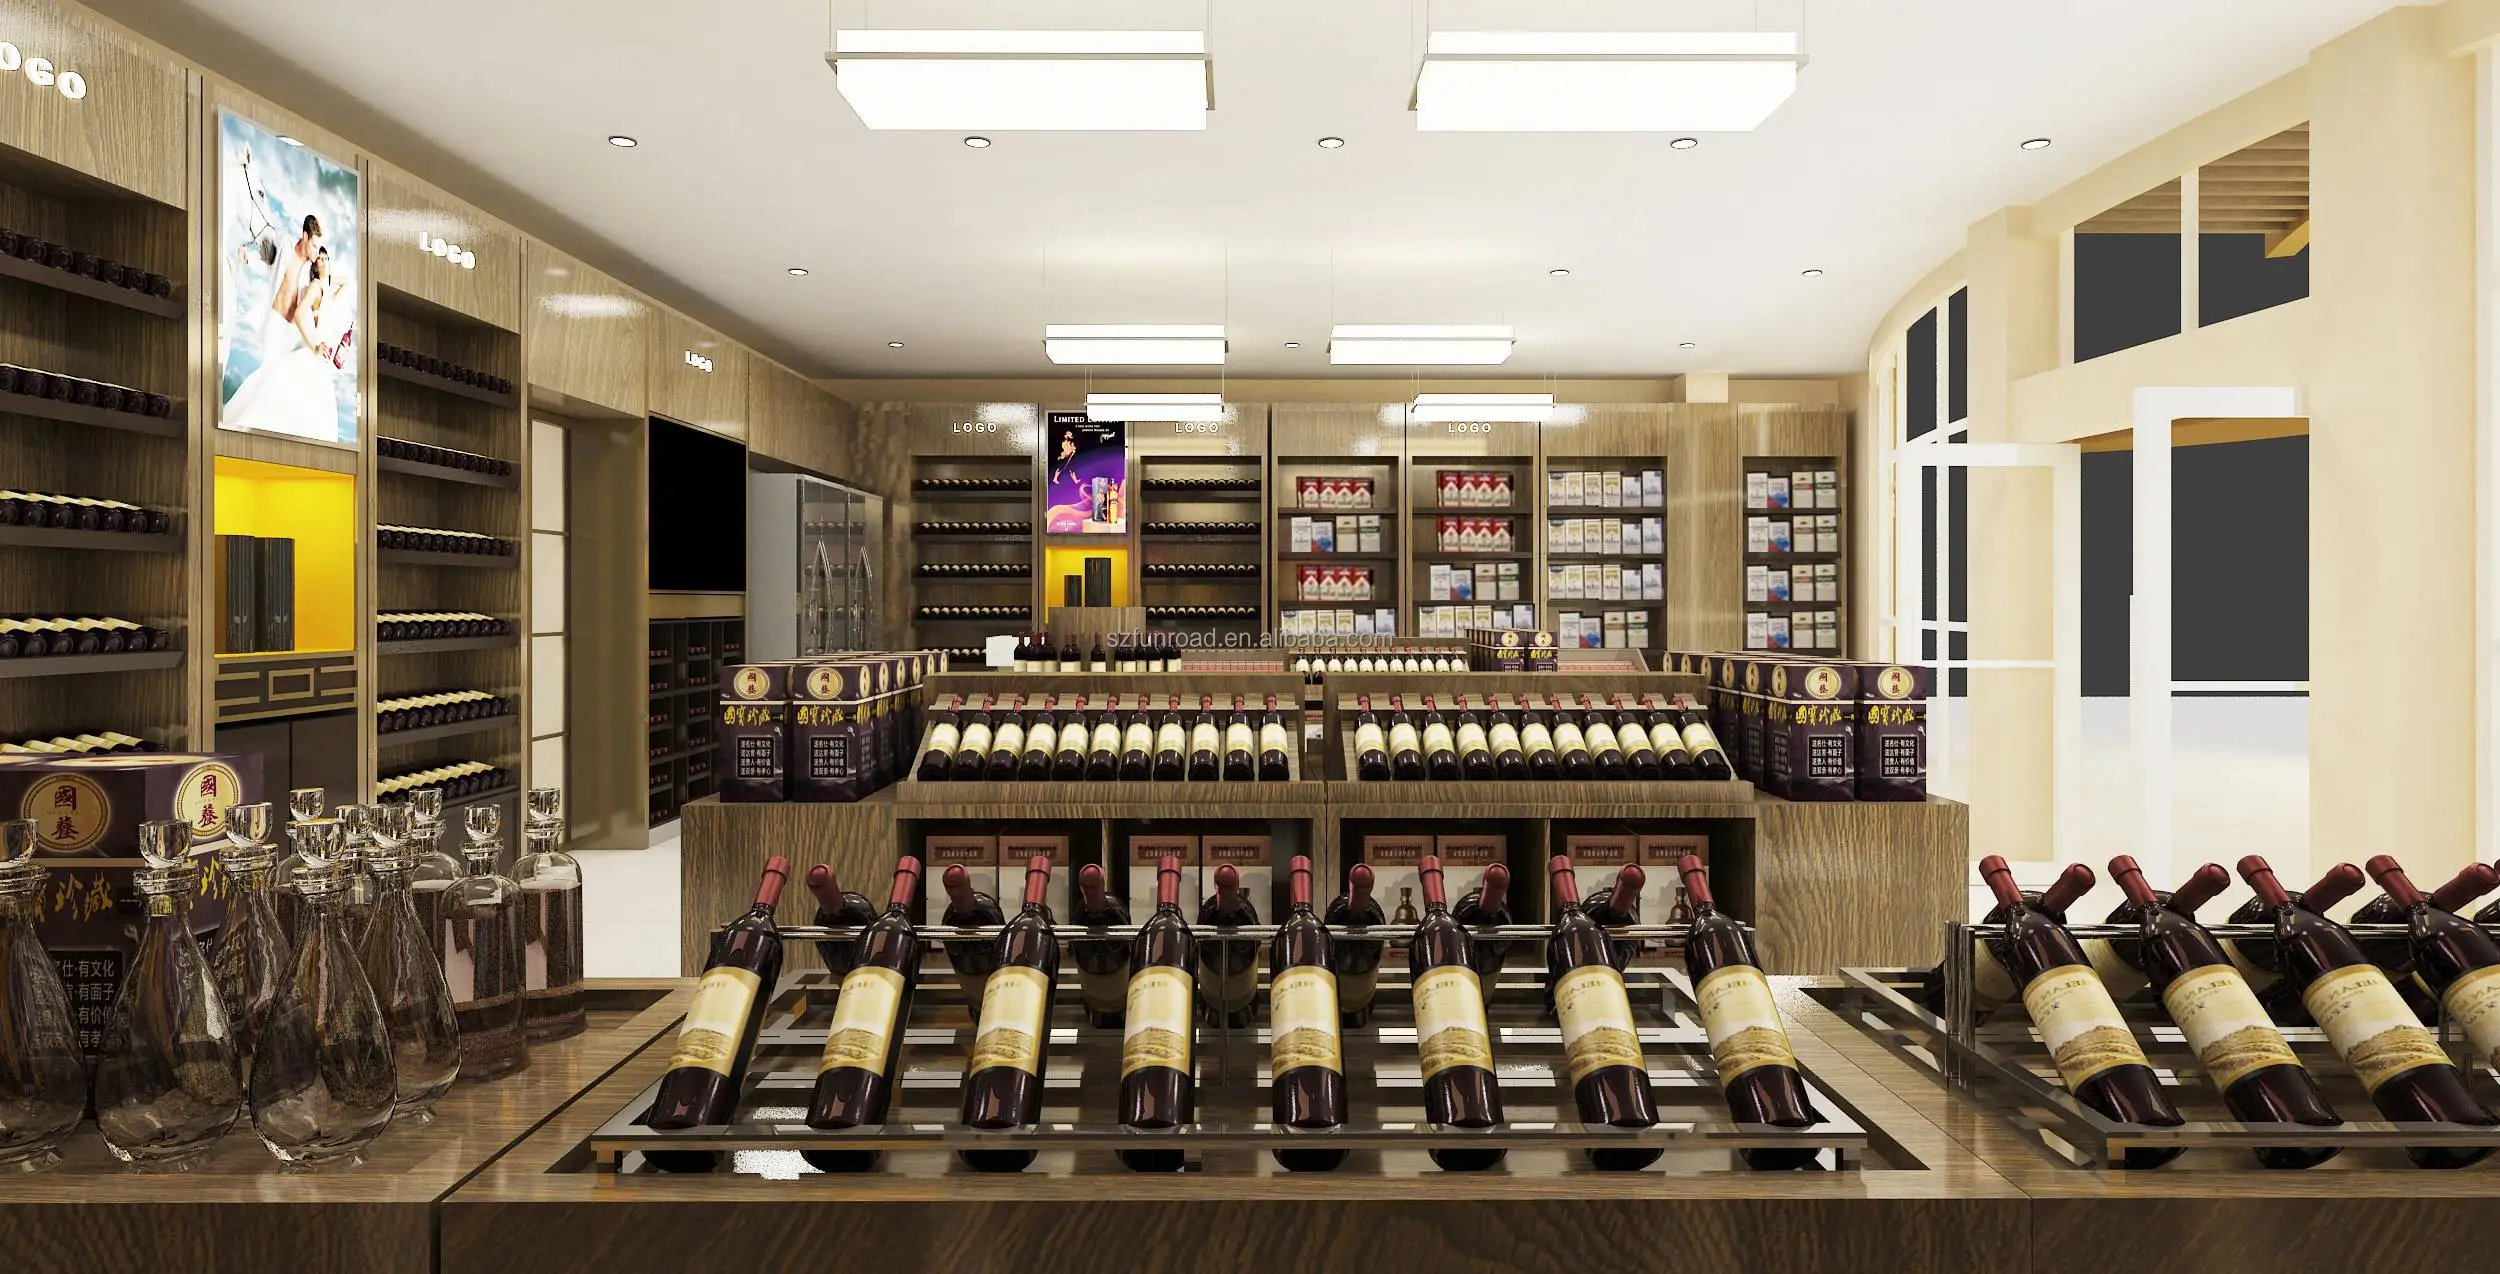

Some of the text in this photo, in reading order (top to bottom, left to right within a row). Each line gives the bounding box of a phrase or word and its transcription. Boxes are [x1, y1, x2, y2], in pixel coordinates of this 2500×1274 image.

[419, 231, 477, 270] LOGO
[684, 350, 714, 373] LOGO
[1053, 415, 1085, 423] LIMITED
[953, 422, 997, 433] LOGO
[1175, 422, 1219, 433] LOGO
[1448, 422, 1492, 433] LOGO
